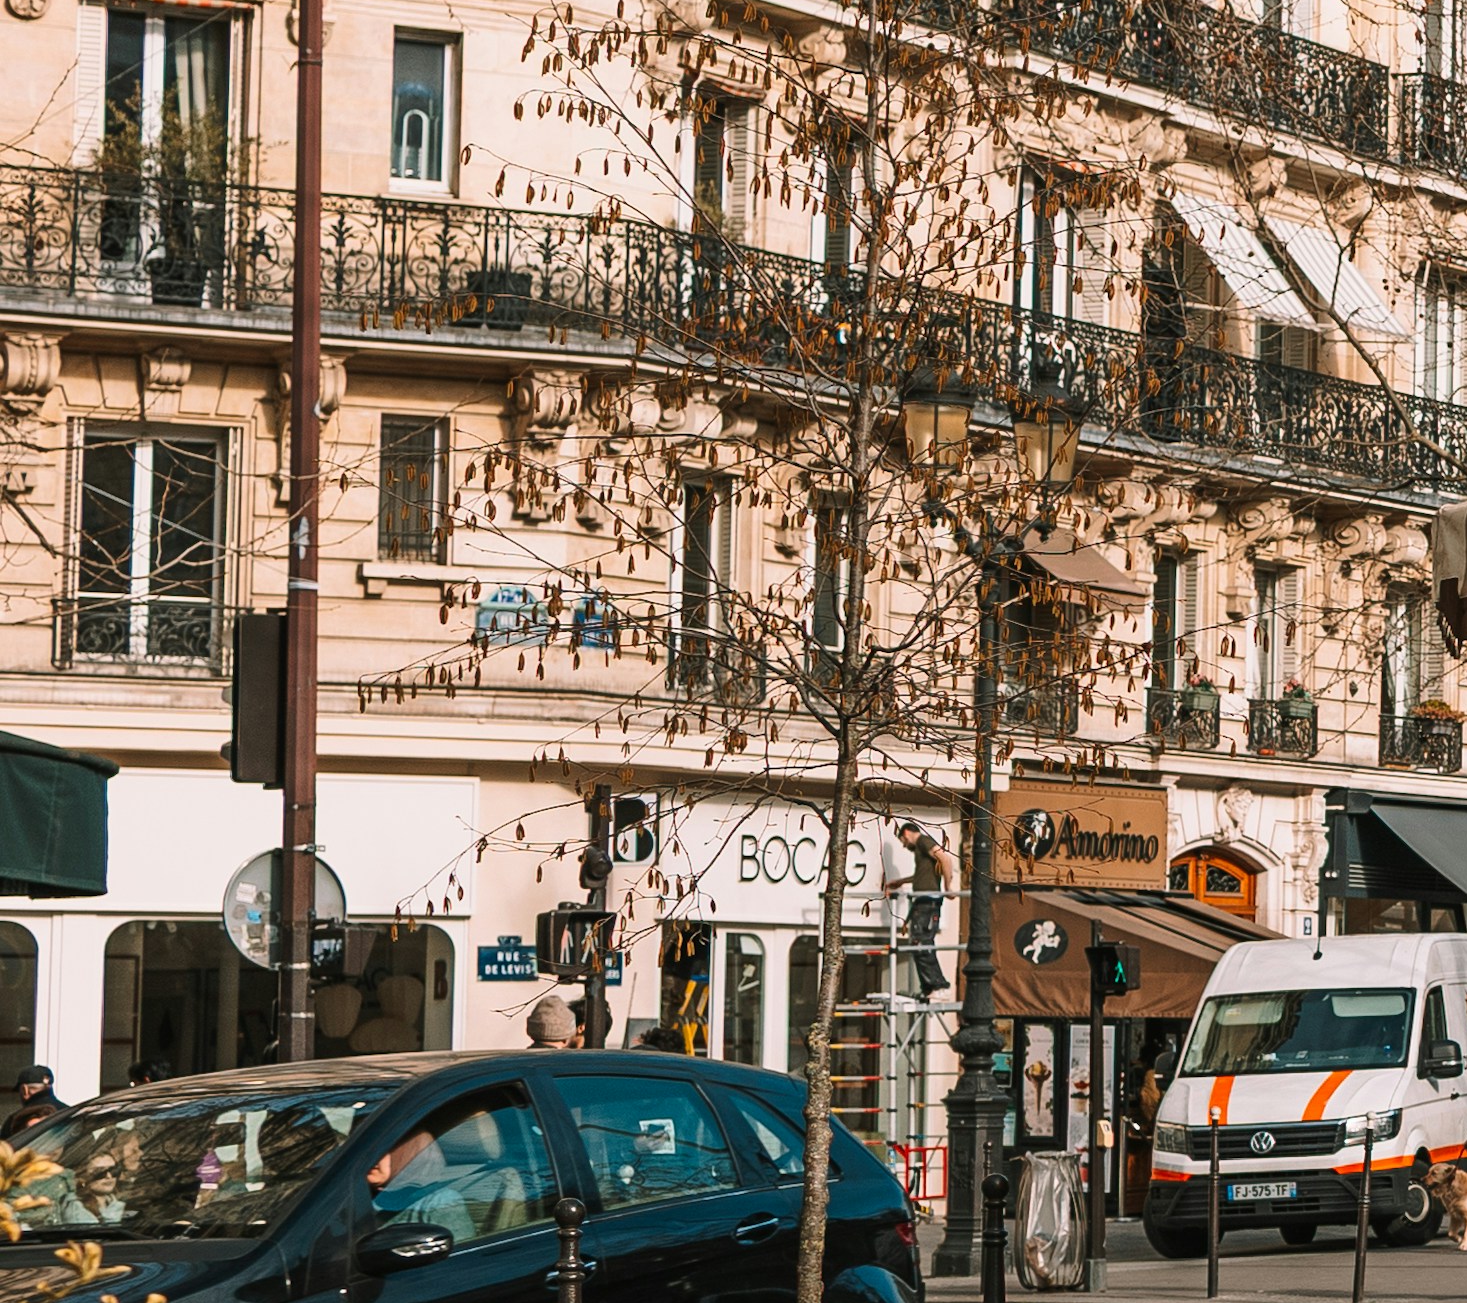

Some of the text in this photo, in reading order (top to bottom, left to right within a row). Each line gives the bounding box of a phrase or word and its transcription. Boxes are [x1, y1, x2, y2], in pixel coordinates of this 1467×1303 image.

[1049, 814, 1159, 864] Amorino
[497, 951, 520, 962] RUE
[485, 964, 498, 975] DE
[1235, 1184, 1288, 1198] FJ-575-TF
